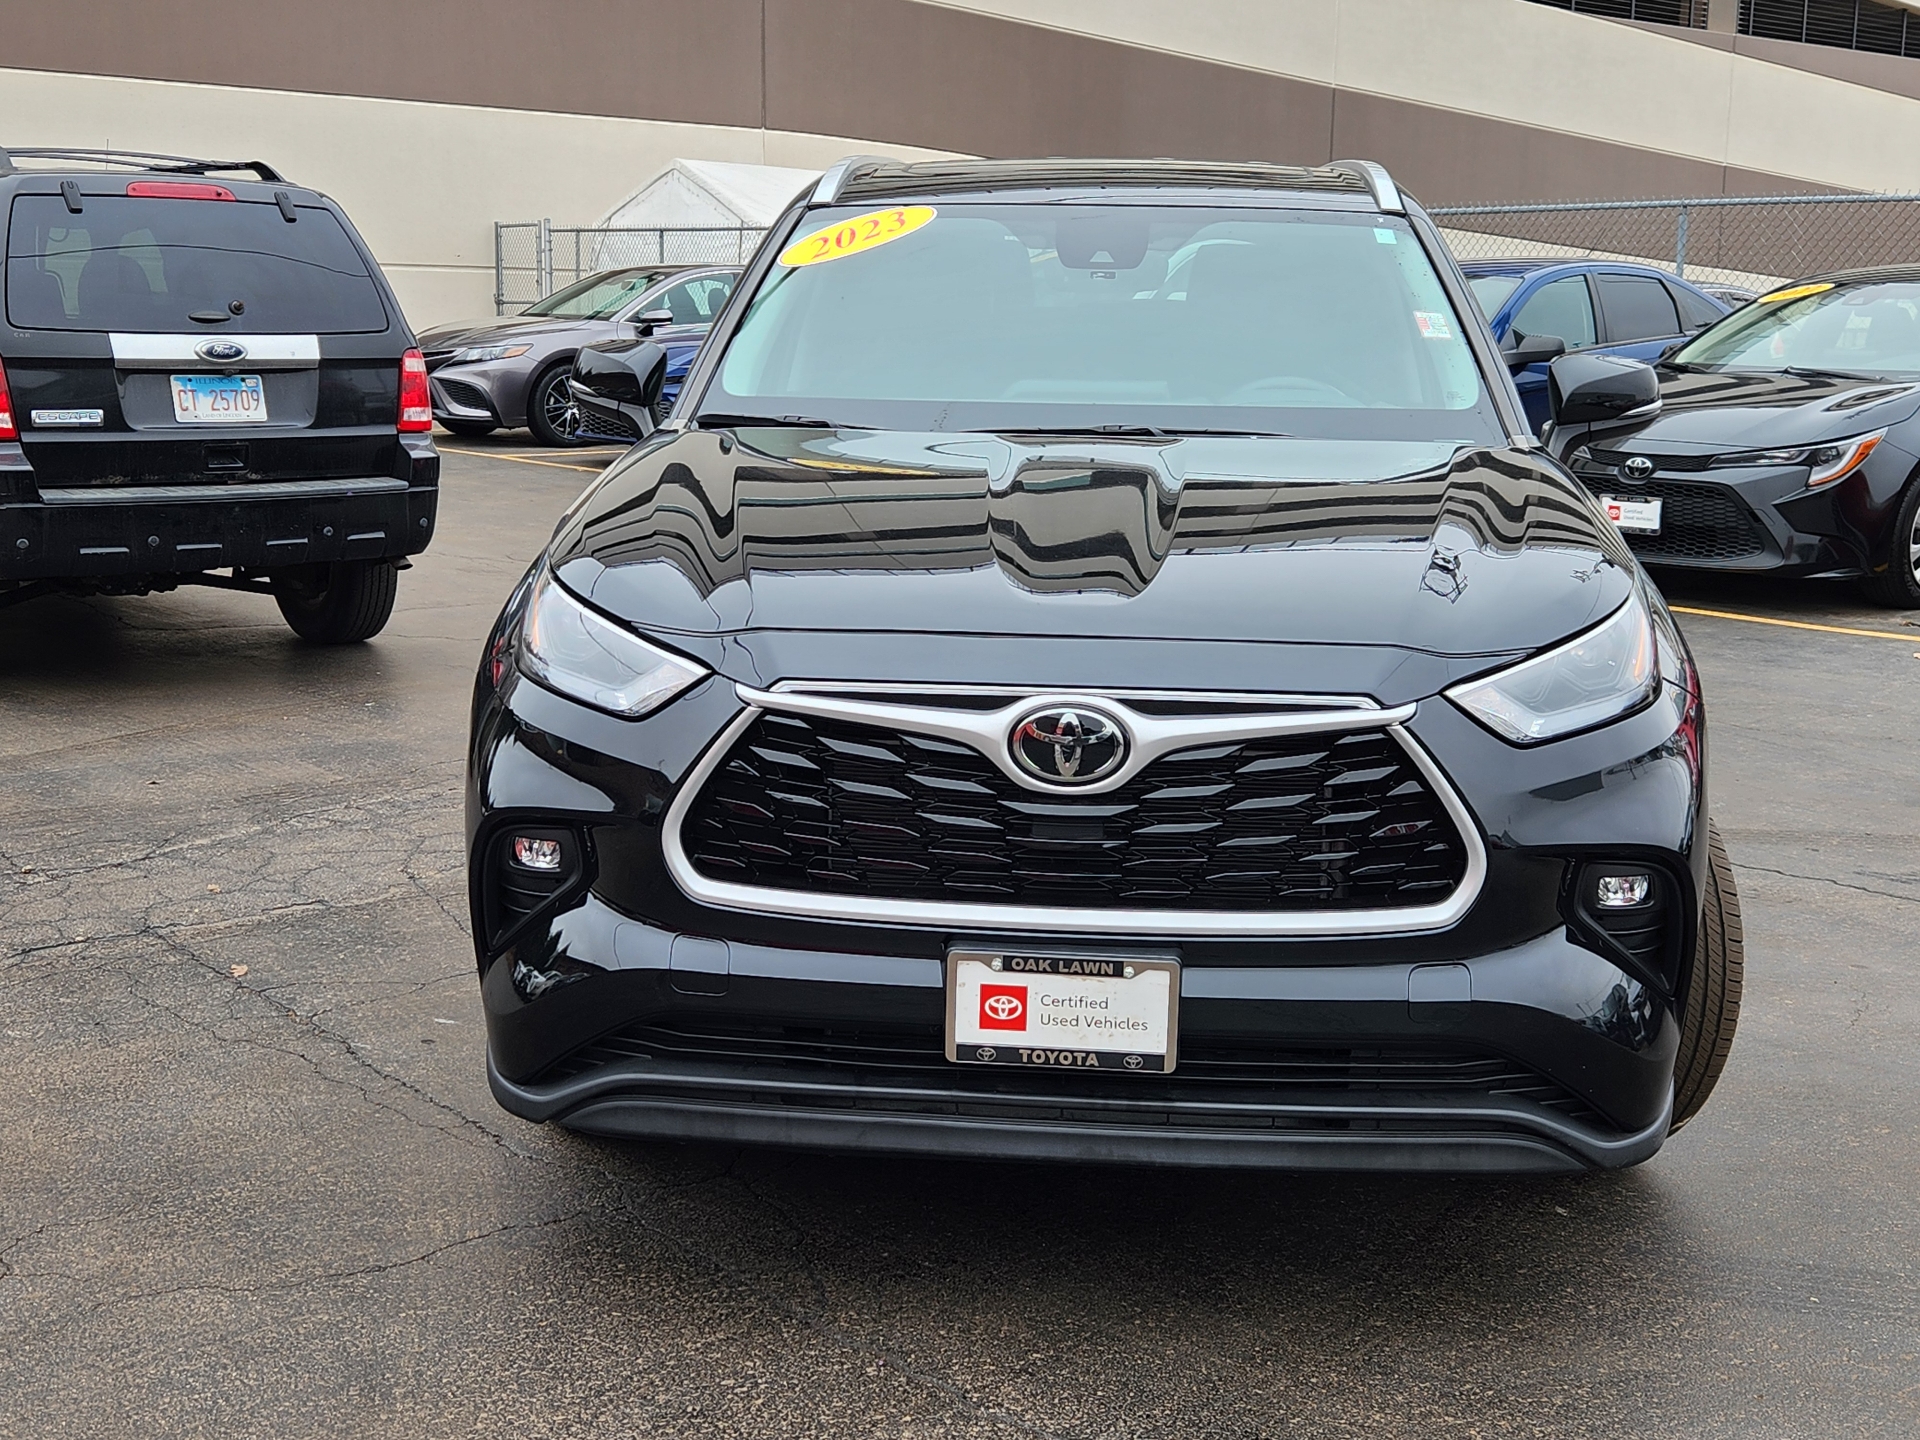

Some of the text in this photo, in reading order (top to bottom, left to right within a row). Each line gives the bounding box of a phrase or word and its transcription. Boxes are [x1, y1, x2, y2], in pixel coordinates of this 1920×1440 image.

[810, 211, 907, 260] 2023
[212, 344, 236, 356] Ford
[195, 377, 239, 385] ILLINOIS
[178, 389, 260, 412] CT 25709
[37, 411, 100, 421] ESCAPE
[1011, 958, 1114, 975] OAK LAWN
[1040, 994, 1109, 1010] Certified
[1040, 1013, 1149, 1032] Used Vehicles
[1019, 1049, 1099, 1067] TOYOTA
